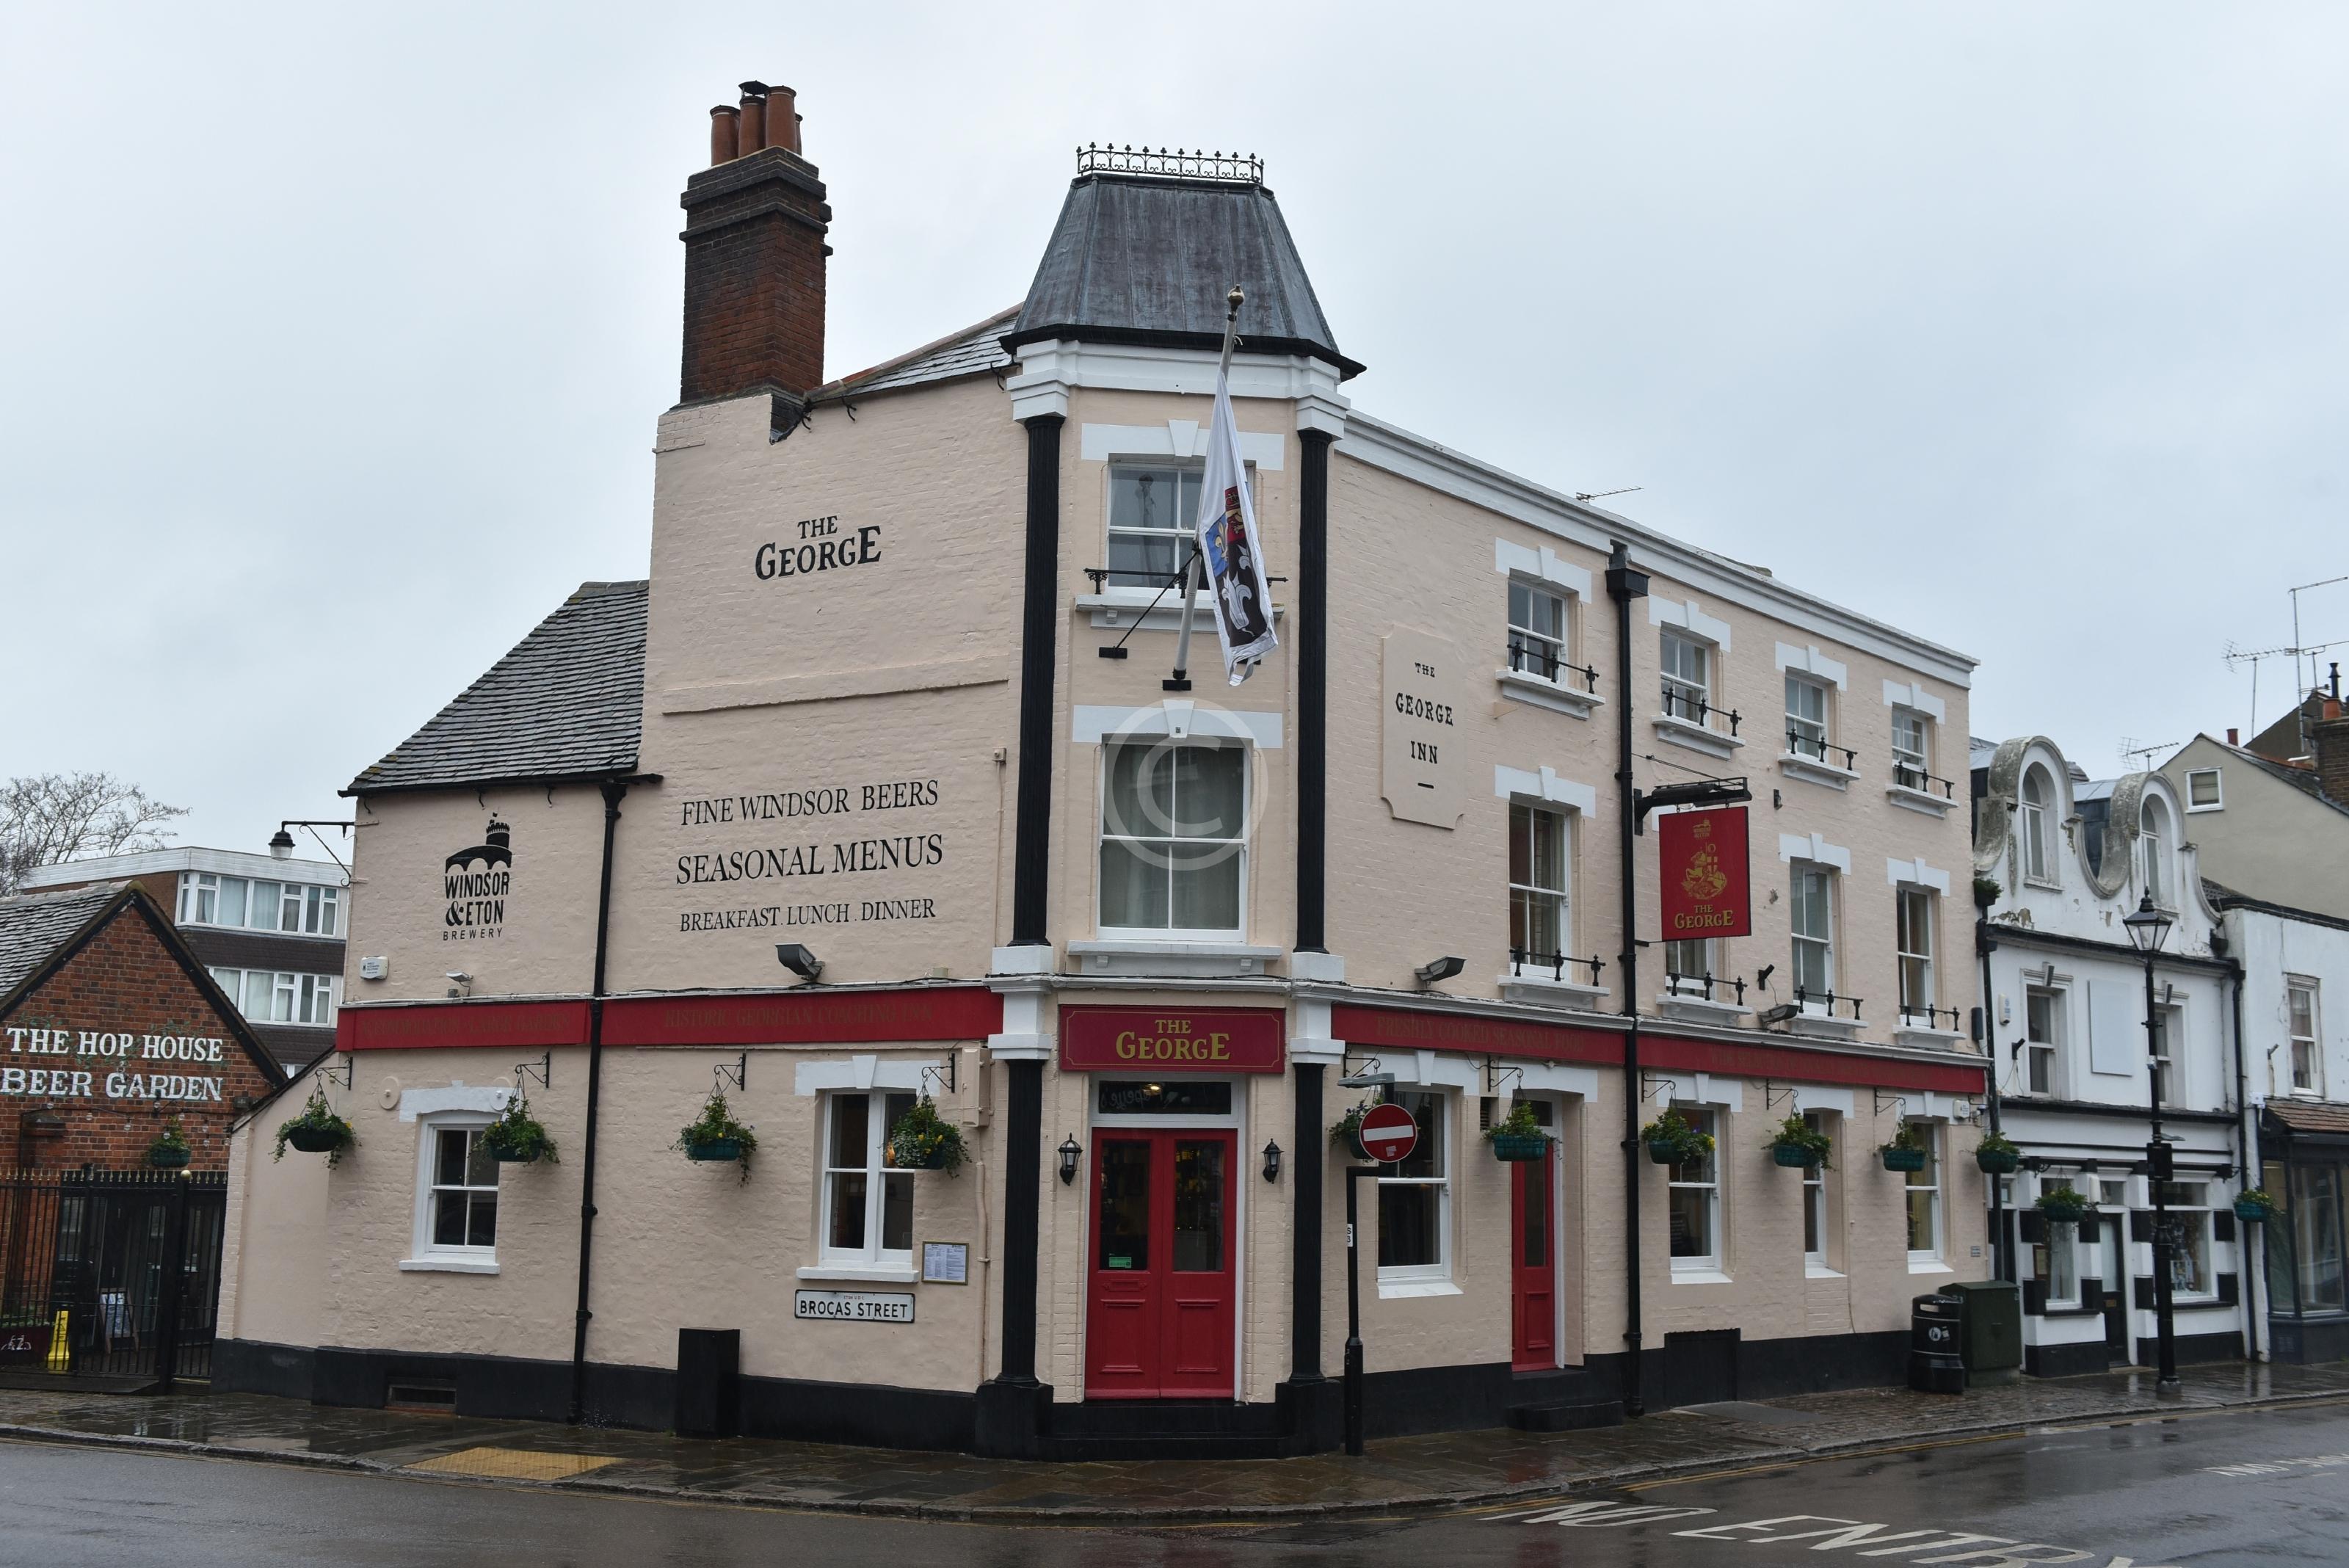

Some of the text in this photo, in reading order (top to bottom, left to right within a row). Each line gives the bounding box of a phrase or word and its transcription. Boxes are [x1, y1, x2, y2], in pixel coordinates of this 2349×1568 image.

[797, 515, 838, 540] THE
[755, 526, 882, 580] GEORGE
[1415, 662, 1435, 678] THE
[1395, 692, 1453, 726] GEORGE
[1410, 740, 1438, 764] INN
[680, 780, 939, 826] FINE WINDSOR BEERS
[676, 834, 943, 884] SEASONAL MENUS
[445, 871, 509, 899] WINDSOR
[786, 903, 849, 924] LUNCH
[861, 898, 935, 921] DINNER
[1674, 910, 1734, 929] GEORGE
[1693, 904, 1713, 913] THE
[443, 928, 503, 940] BREWERY
[1155, 1019, 1191, 1034] THE
[7, 1028, 223, 1061] THE HOP HOUSE
[1115, 1032, 1231, 1061] GEORGE
[0, 1067, 223, 1101] BEER GARDEN
[800, 1300, 907, 1318] BROCAS STREET
[1475, 1501, 1718, 1527] NO
